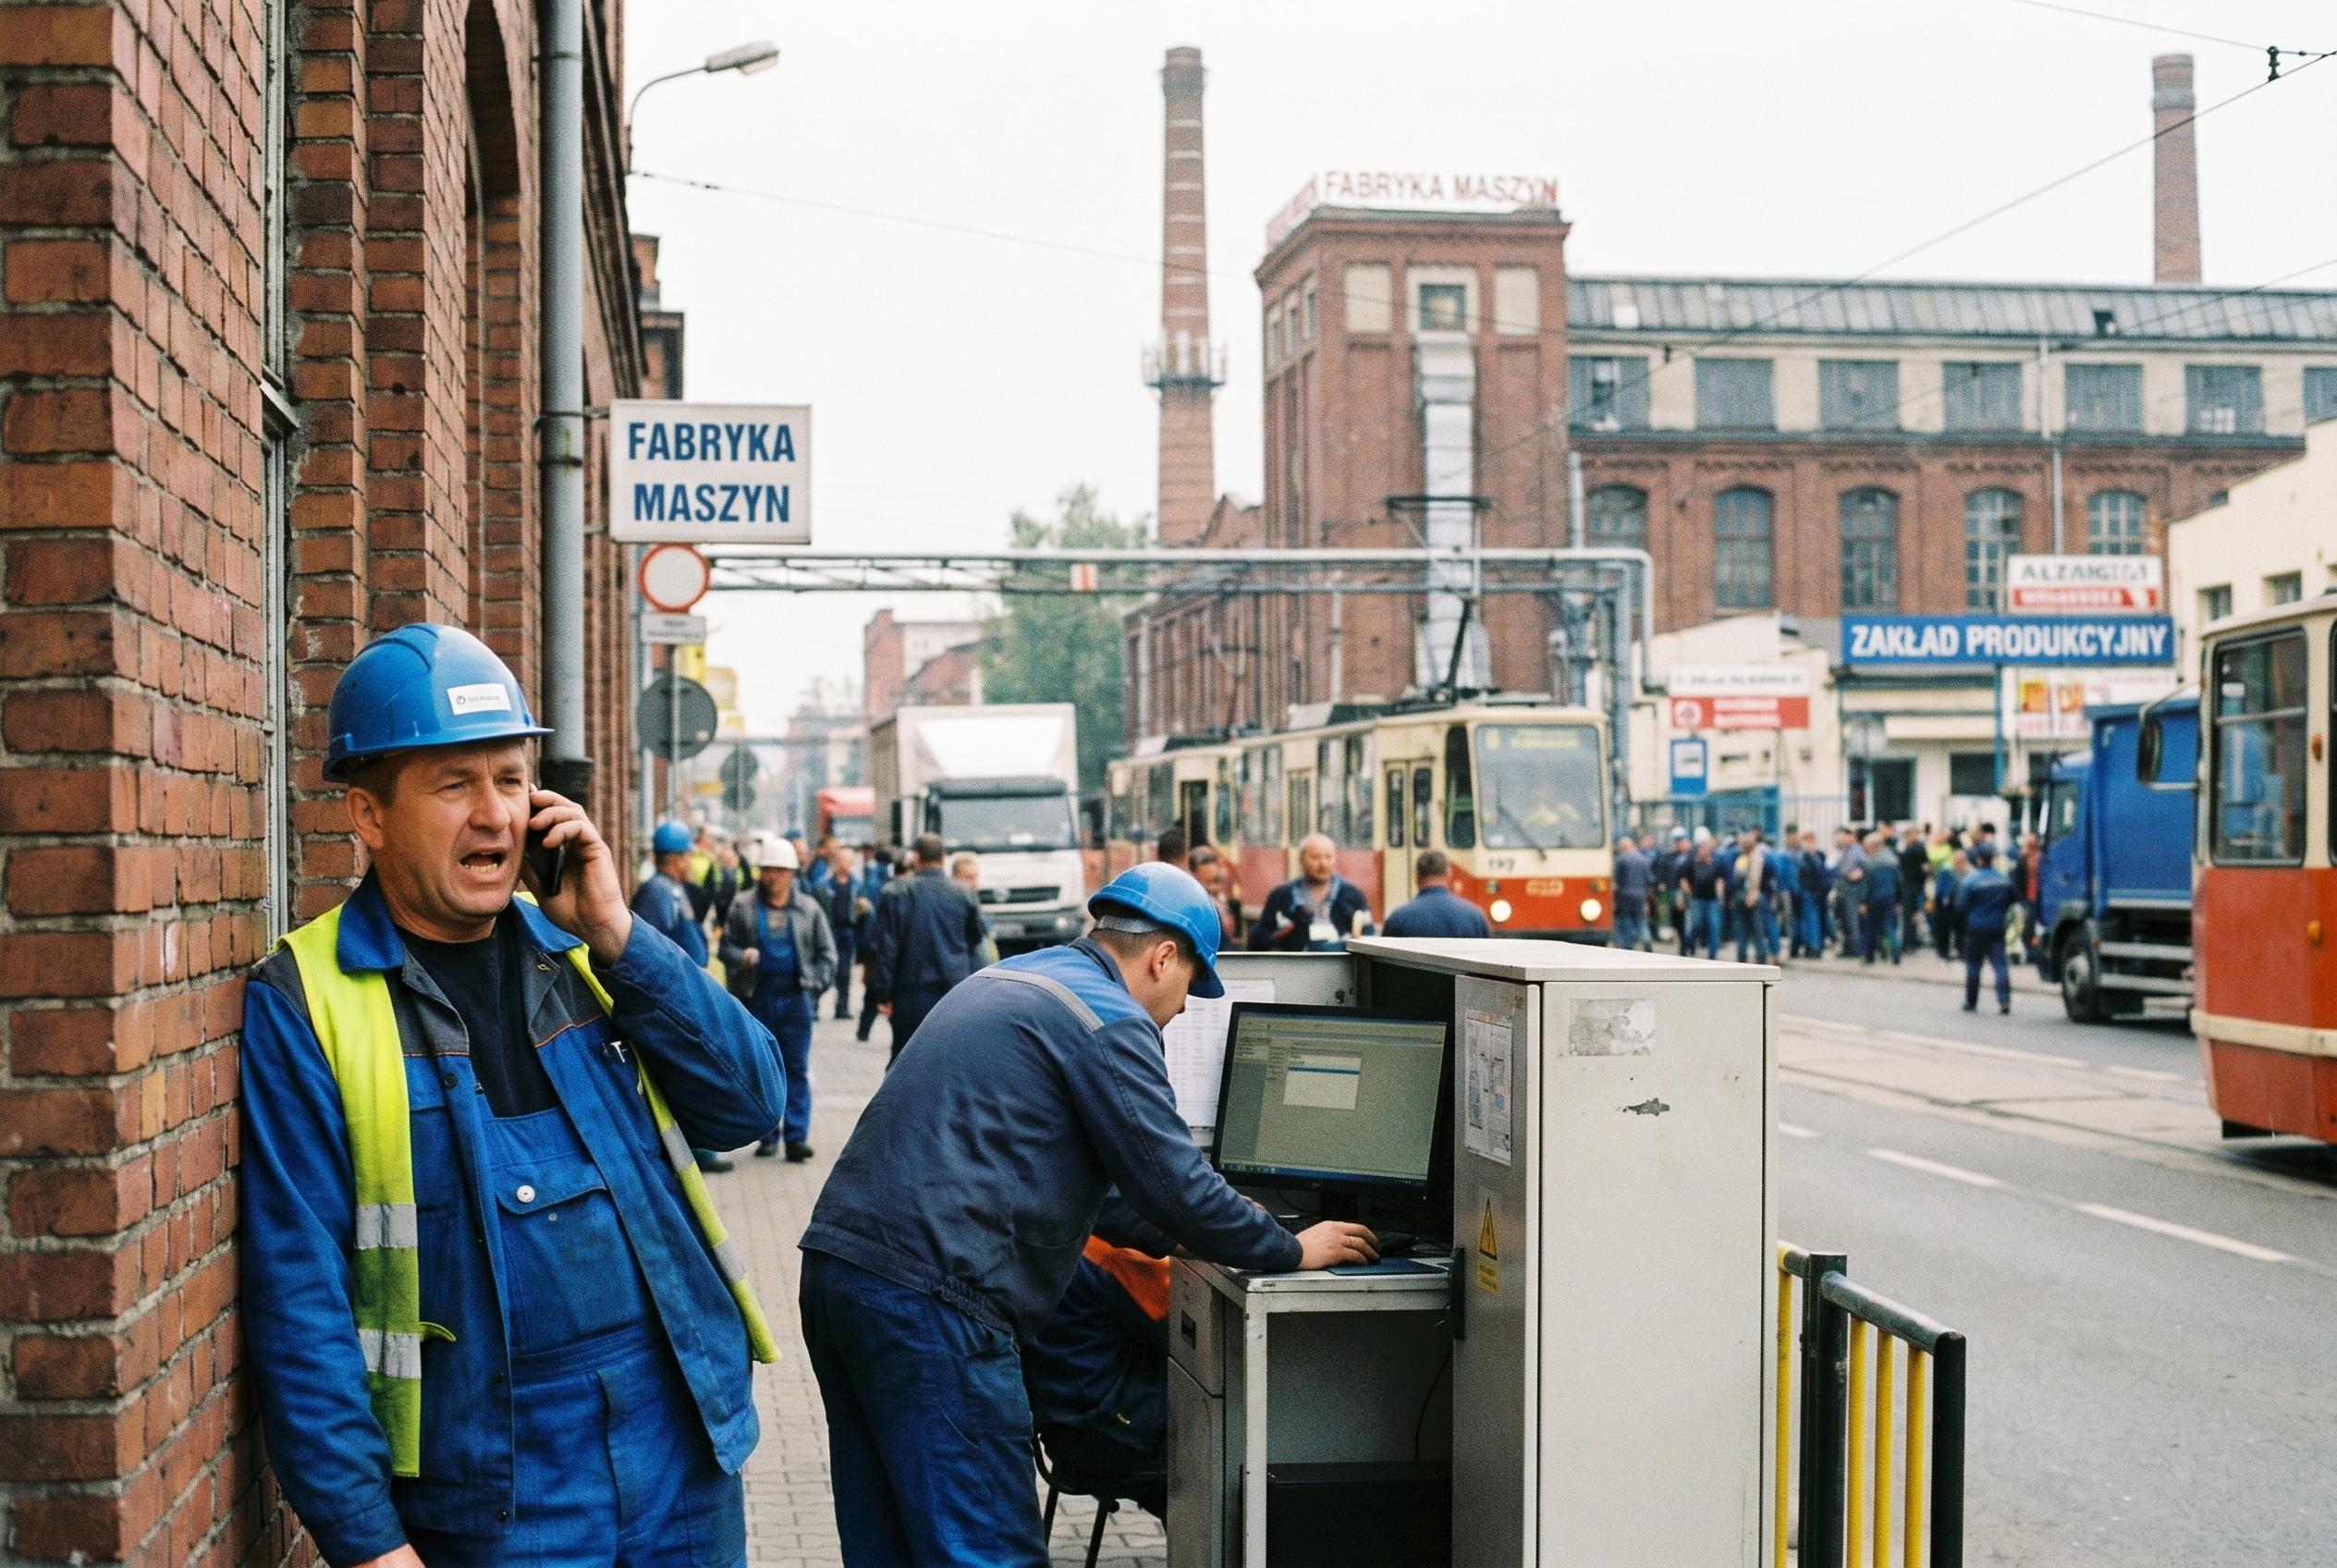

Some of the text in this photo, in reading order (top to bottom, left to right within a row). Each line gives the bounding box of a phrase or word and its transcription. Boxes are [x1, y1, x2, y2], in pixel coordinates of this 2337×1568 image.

[1324, 170, 1559, 204] FABRYKA MASZYN
[629, 422, 795, 461] FABRYKA
[633, 484, 789, 522] MASZYN
[1851, 624, 2169, 657] ZAKŁAD PRODUKCYJNY
